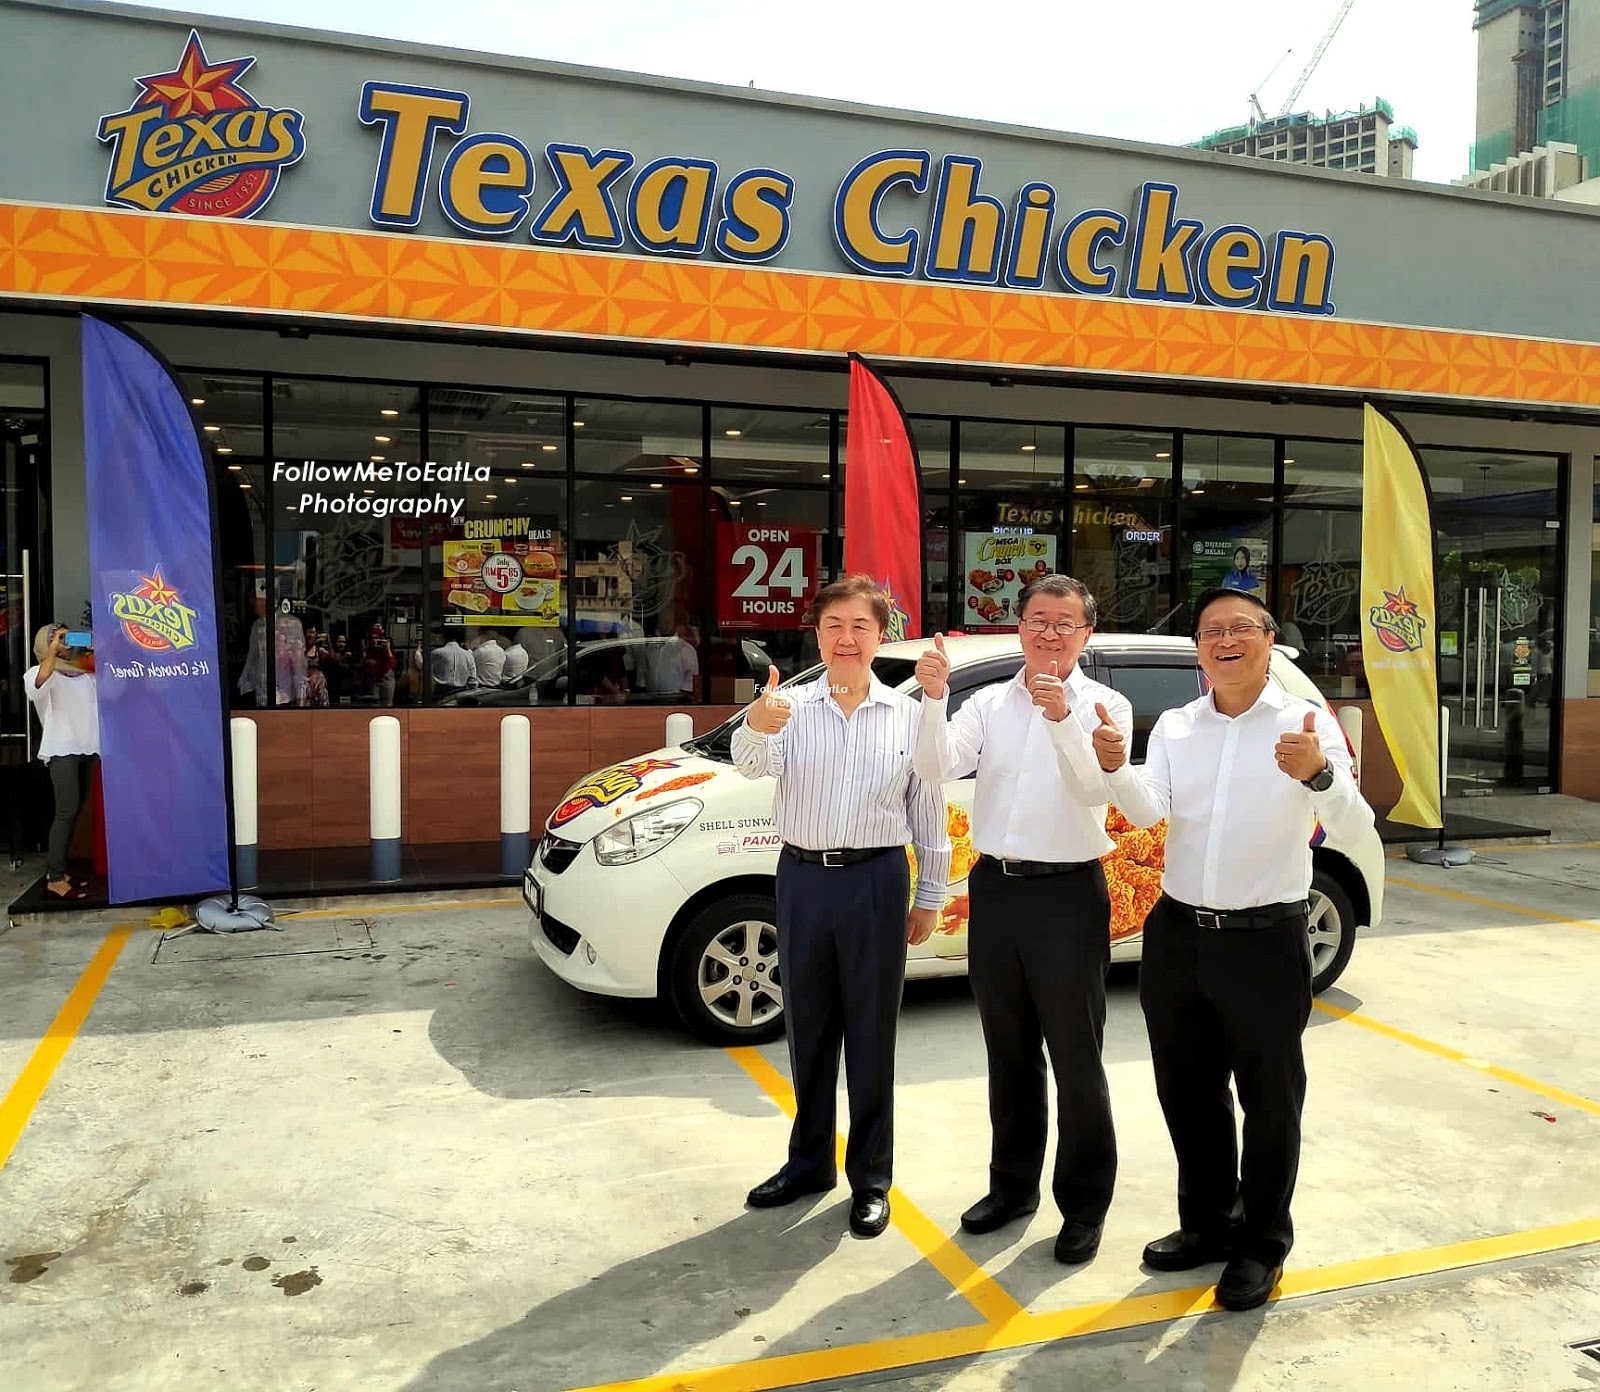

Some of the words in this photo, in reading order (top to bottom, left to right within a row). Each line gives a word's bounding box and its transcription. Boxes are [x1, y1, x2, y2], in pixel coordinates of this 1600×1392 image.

[104, 105, 296, 190] Texas
[147, 154, 238, 198] CHICKEN
[187, 198, 233, 211] SINCE
[358, 80, 795, 263] Texas
[834, 149, 1336, 316] Chicken
[997, 503, 1054, 525] Texas
[1060, 505, 1138, 527] hicken
[464, 517, 531, 539] CRUNCHY
[528, 530, 551, 540] DEALS
[747, 528, 790, 542] OPEN
[1125, 530, 1160, 541] ORDER
[995, 537, 1018, 545] MEGA
[731, 544, 809, 598] 24
[742, 600, 795, 614] HOURS
[699, 820, 735, 832] SHELL
[737, 817, 776, 829] SUNW
